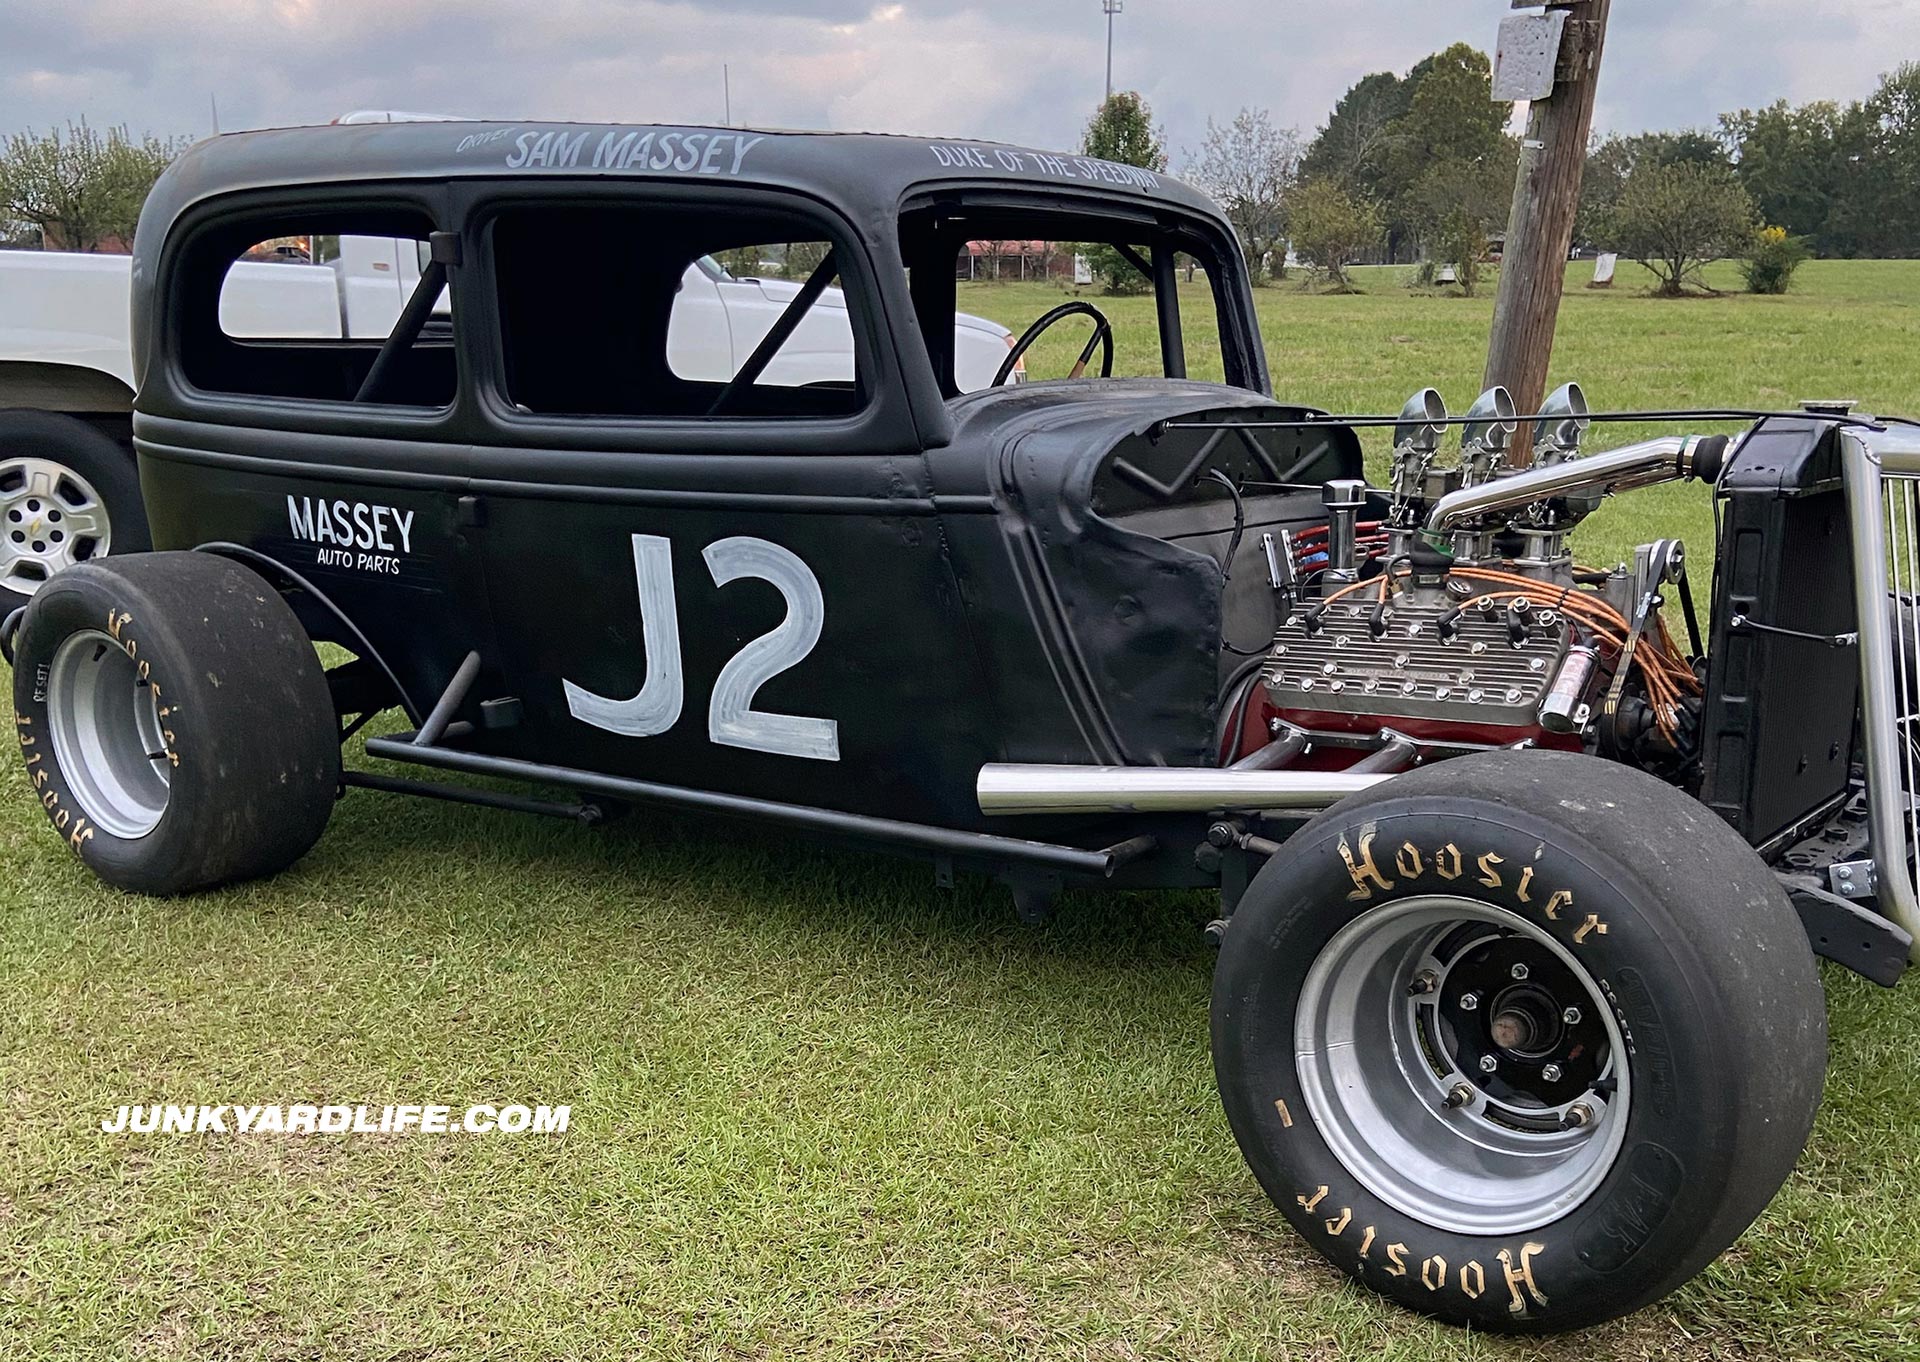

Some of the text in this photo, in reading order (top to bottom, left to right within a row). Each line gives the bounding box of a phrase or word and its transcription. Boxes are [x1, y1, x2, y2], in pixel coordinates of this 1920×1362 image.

[506, 131, 764, 175] SAM MASSEY
[929, 145, 1161, 189] DUKE OF THE SPEEDWAY
[287, 494, 414, 553] MASSEY
[317, 548, 400, 575] AUTO PARTS
[109, 608, 180, 767] Hoosier
[562, 533, 840, 761] J2
[1337, 821, 1608, 944] Hoosier
[1297, 1185, 1548, 1319] Hoosier
